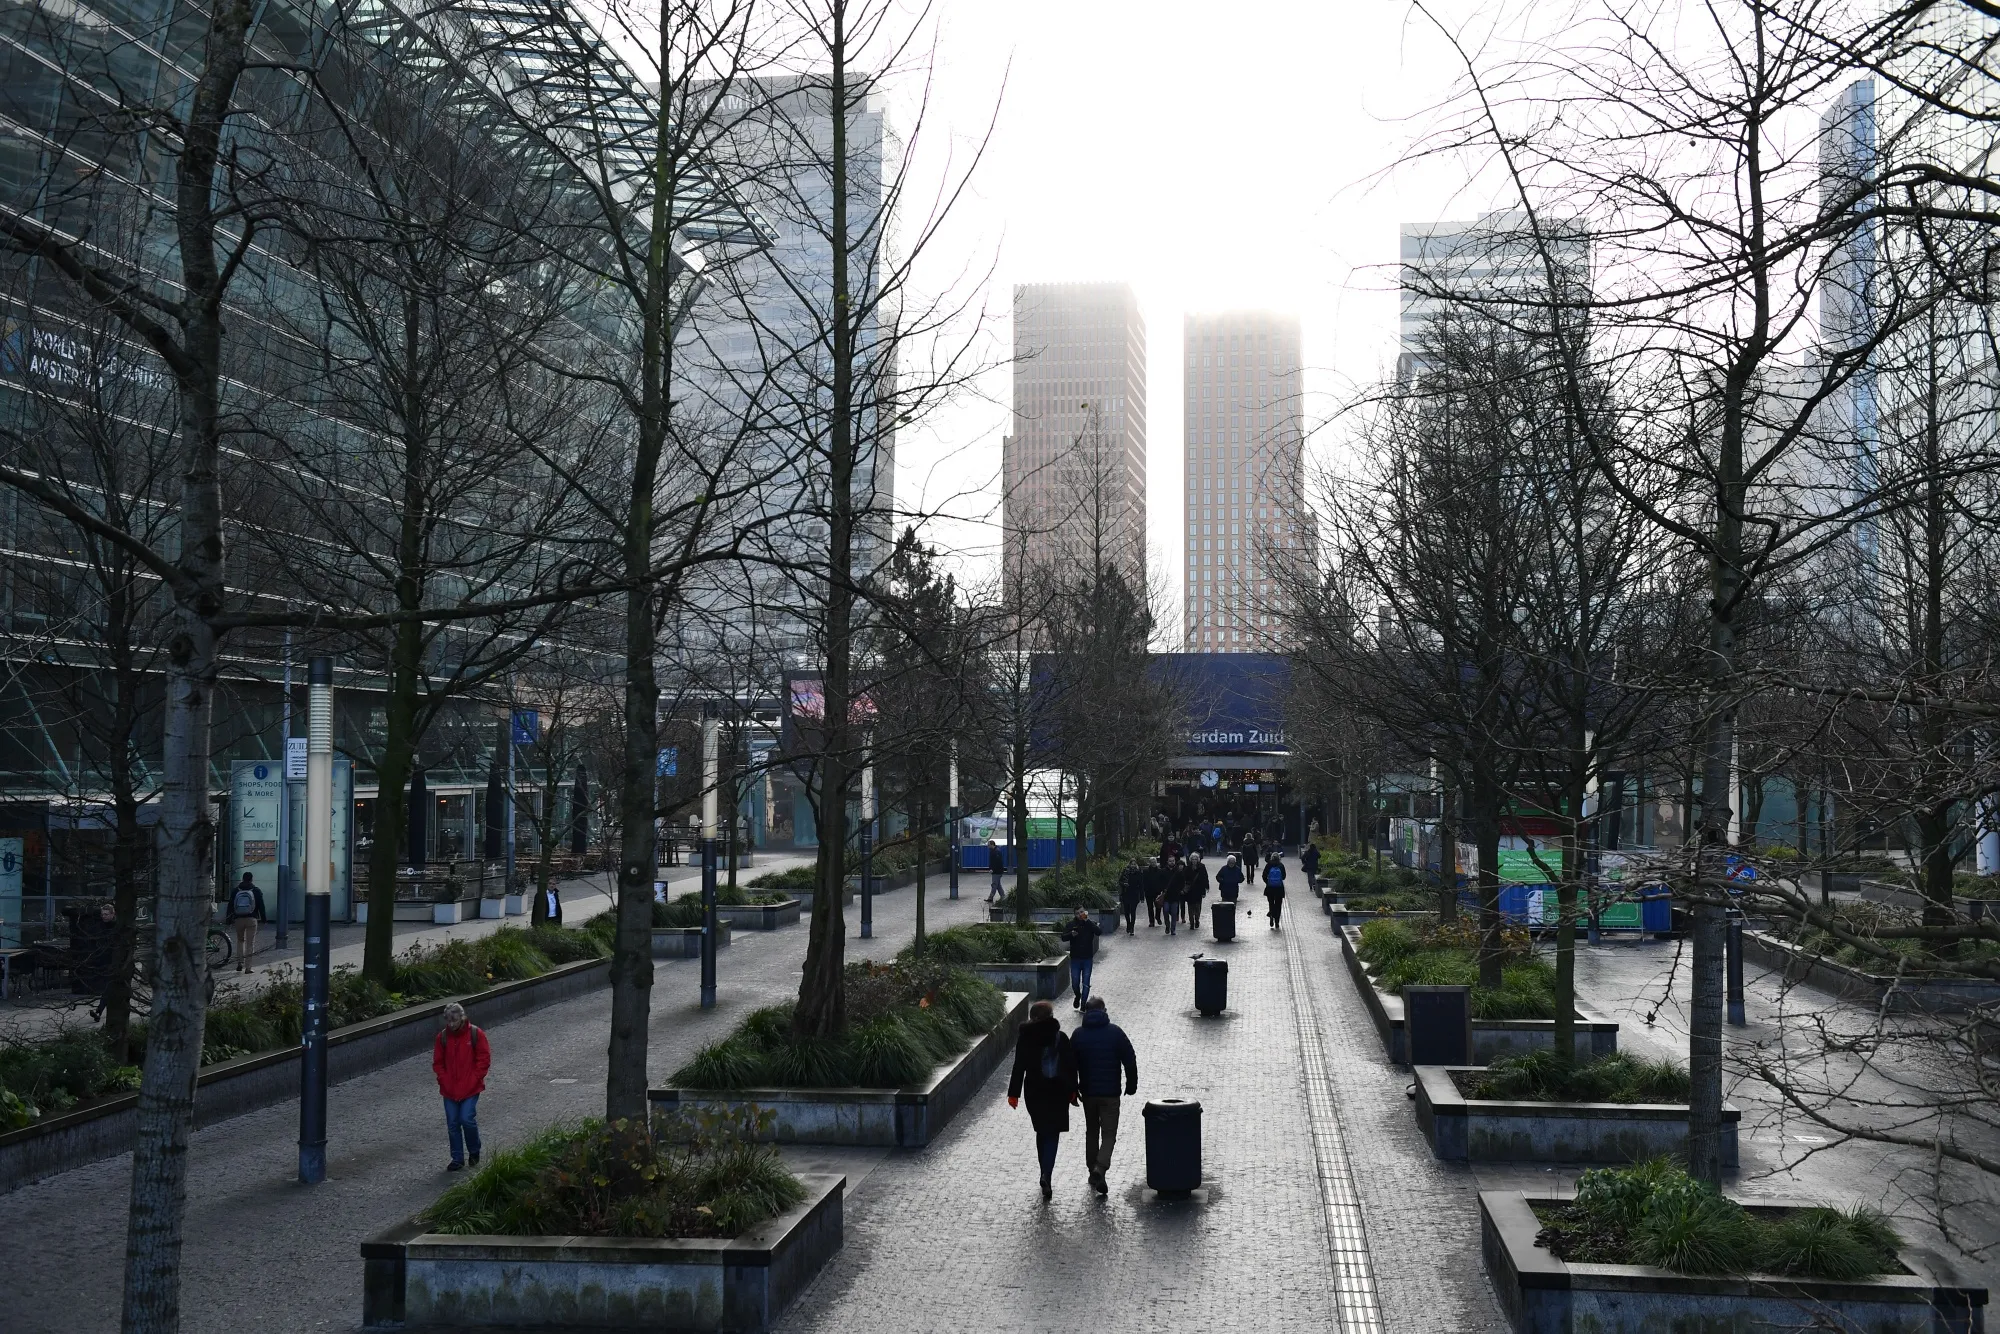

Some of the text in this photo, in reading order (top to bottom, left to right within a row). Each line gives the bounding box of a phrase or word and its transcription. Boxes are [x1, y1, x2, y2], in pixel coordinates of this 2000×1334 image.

[32, 327, 77, 360] WORLD
[1248, 729, 1285, 744] Zuid
[239, 781, 263, 789] SHOPS,
